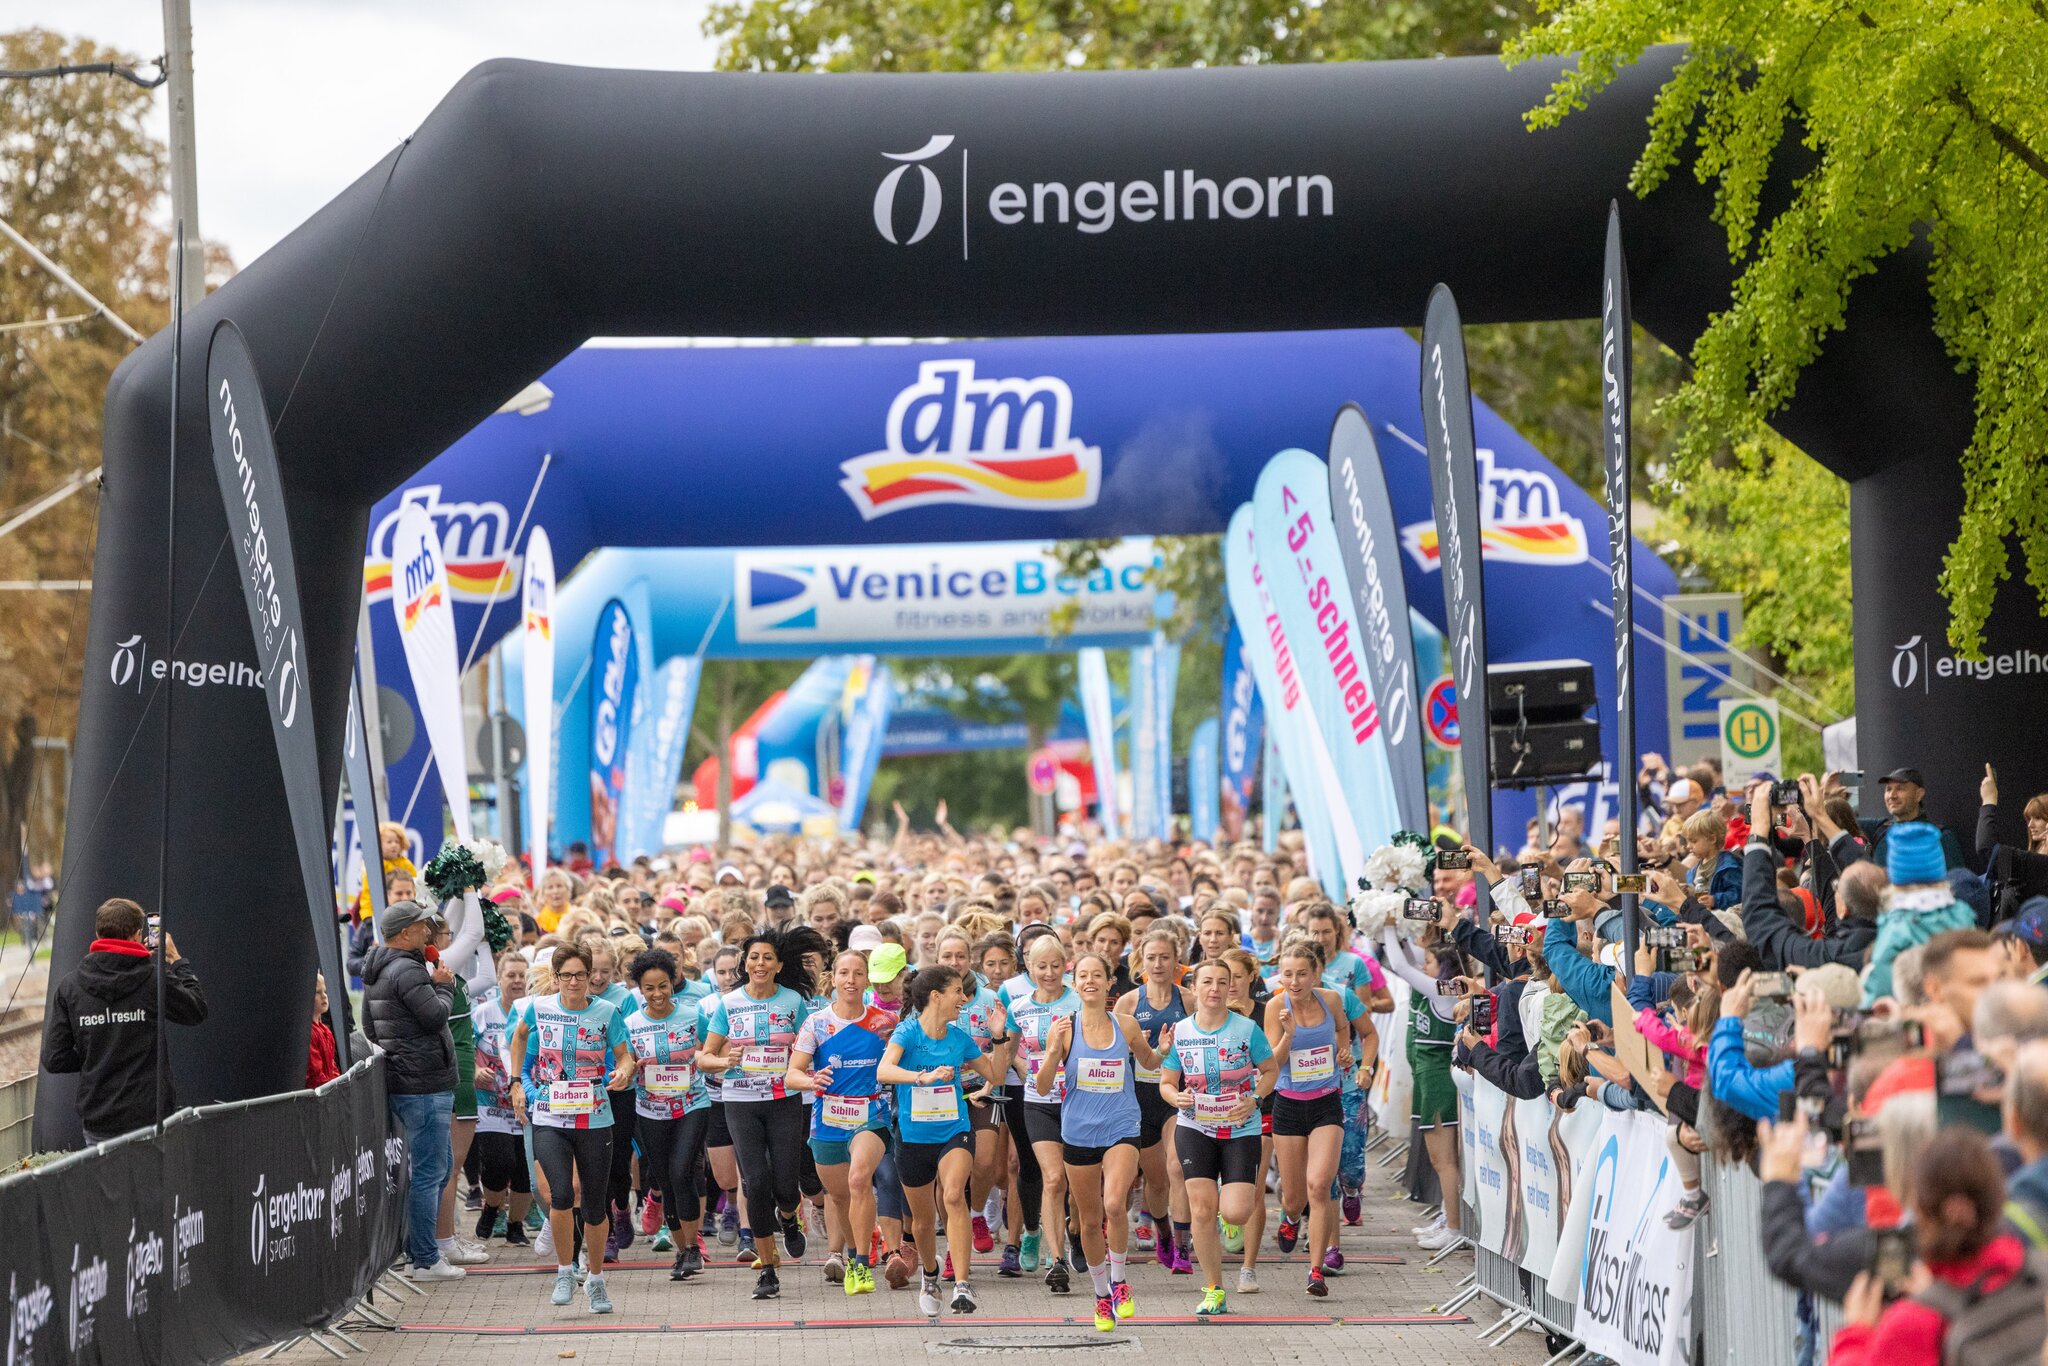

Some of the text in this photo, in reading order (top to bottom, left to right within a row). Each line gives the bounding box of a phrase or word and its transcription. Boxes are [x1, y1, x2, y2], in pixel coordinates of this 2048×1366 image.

[988, 169, 1334, 234] engelhorn
[892, 362, 1068, 457] dm
[829, 557, 1163, 600] VeniceBeac
[895, 607, 991, 630] fitness
[1308, 576, 1381, 746] schnell
[1739, 715, 1761, 746] H
[79, 1008, 146, 1027] race result
[745, 1054, 785, 1063] Ana Maria
[1298, 1057, 1327, 1068] Saskia
[655, 1073, 679, 1082] Doris
[1088, 1068, 1115, 1079] Alicia
[553, 1090, 589, 1100] Barbara
[830, 1105, 860, 1117] Sibille
